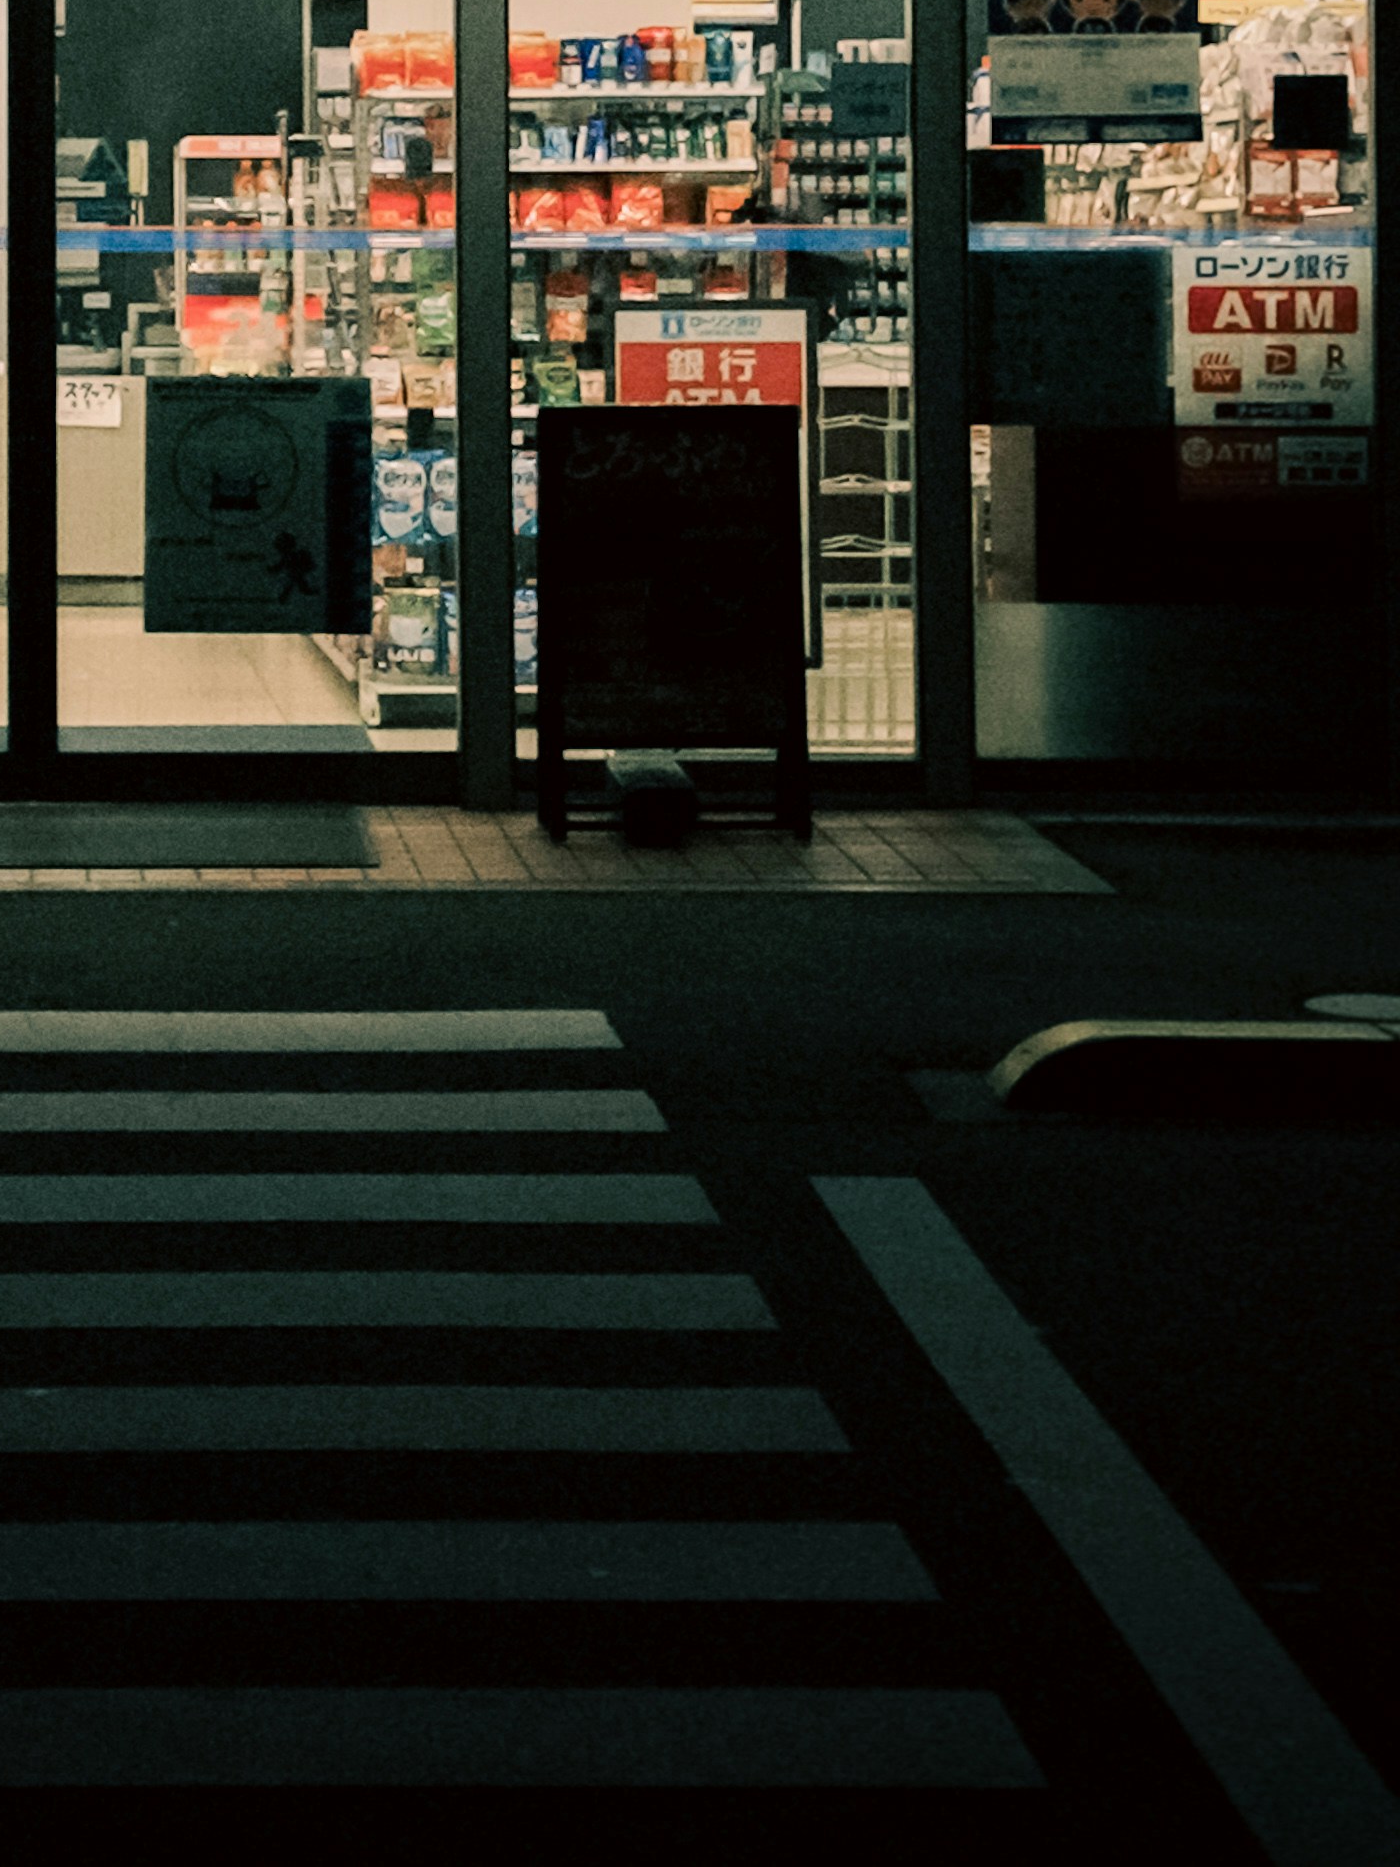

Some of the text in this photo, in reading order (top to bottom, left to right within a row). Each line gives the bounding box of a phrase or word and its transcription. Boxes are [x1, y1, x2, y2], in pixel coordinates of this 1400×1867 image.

[1194, 254, 1350, 281] ローソン銀行
[1212, 290, 1335, 330] ATM
[666, 347, 758, 383] 銀行
[1214, 442, 1274, 464] ATM
